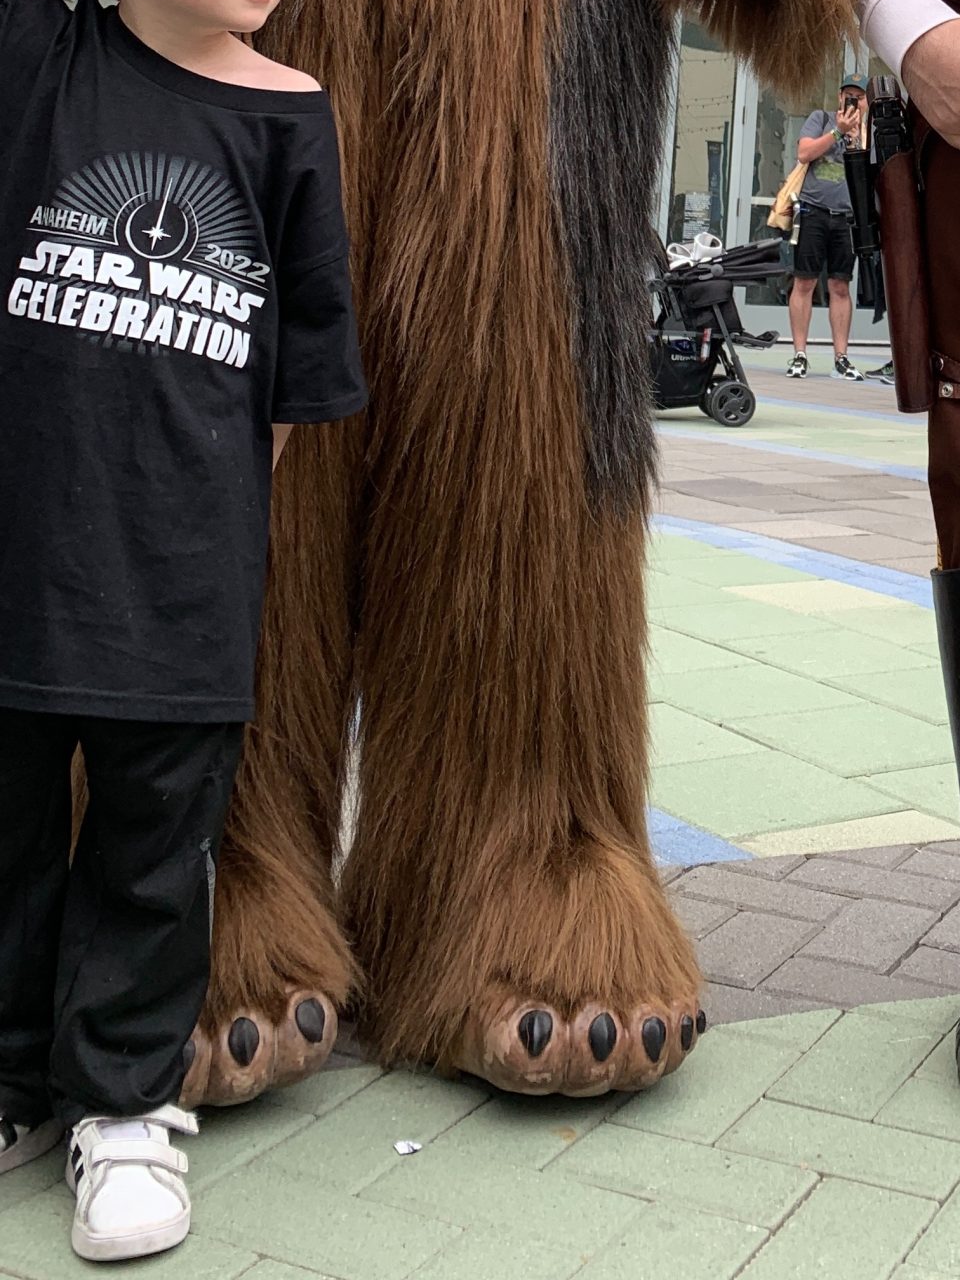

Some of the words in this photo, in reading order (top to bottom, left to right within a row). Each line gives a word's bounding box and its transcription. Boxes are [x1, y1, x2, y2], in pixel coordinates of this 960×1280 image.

[30, 205, 108, 236] ANAHEIM
[19, 240, 142, 290] STAR
[149, 261, 265, 323] WARS
[204, 243, 271, 283] 2022
[7, 277, 252, 369] CELEBRATION
